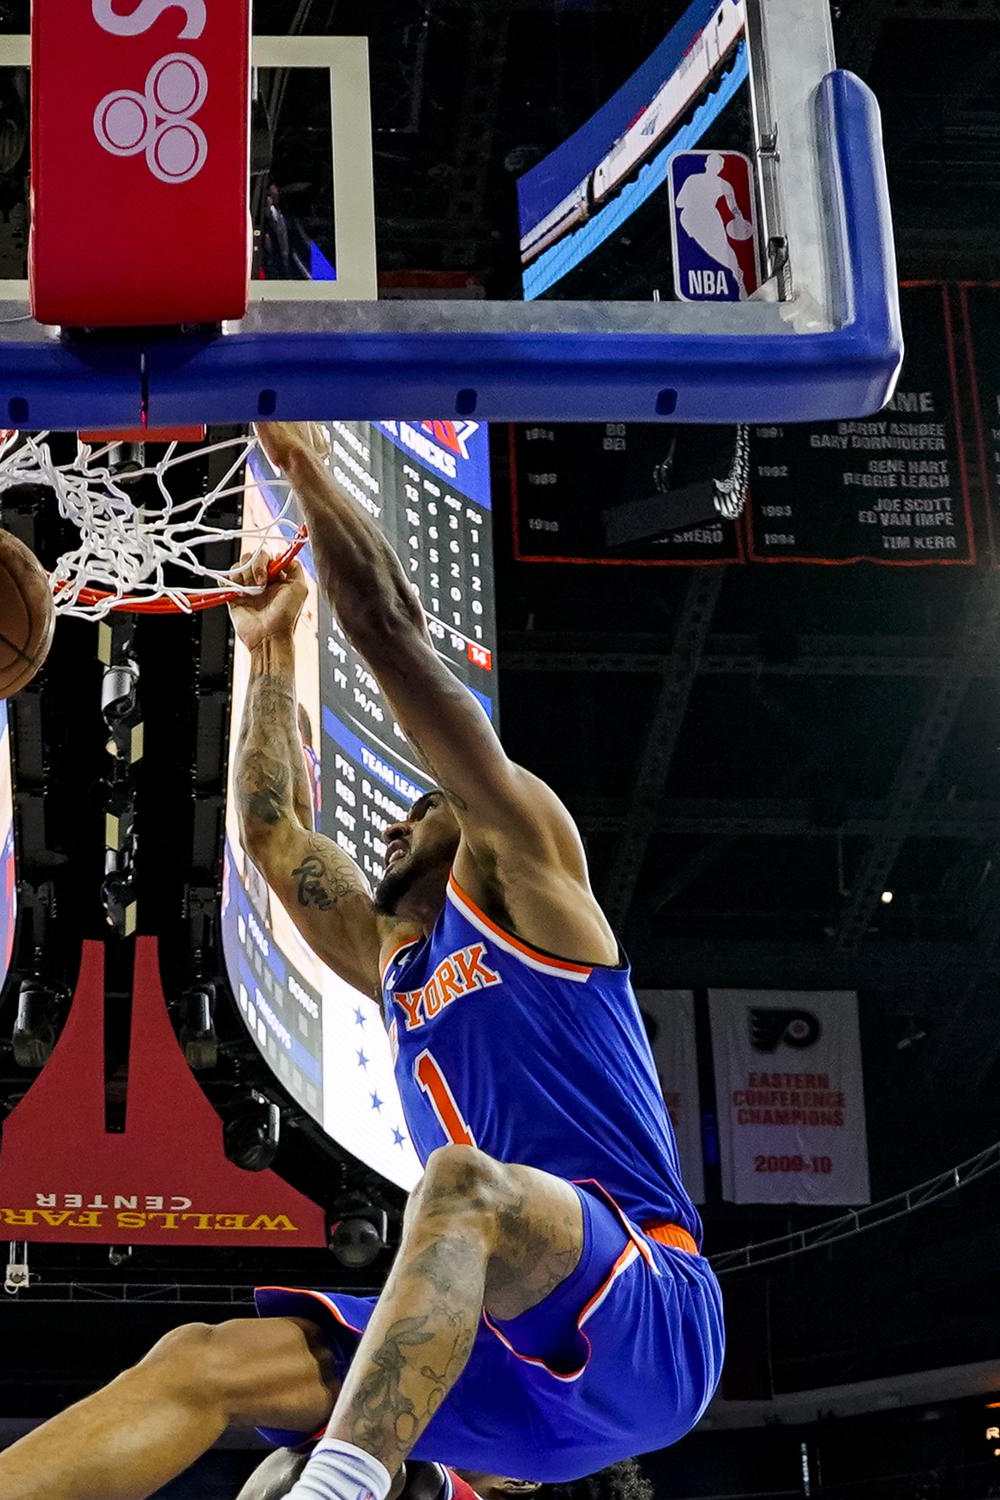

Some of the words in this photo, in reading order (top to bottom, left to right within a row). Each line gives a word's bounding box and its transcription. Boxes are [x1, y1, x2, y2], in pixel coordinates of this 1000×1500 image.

[689, 270, 729, 295] NBA
[838, 422, 888, 435] BARRY
[868, 459, 905, 473] GENE
[908, 460, 948, 473] HART
[843, 473, 898, 487] REGGIE
[901, 474, 950, 487] LEACH
[874, 498, 902, 511] JOE
[904, 497, 952, 511] SCOTT
[879, 513, 912, 526] VAN
[915, 513, 954, 526] IMPE
[882, 536, 911, 549] TIM
[914, 536, 957, 549] KERR
[335, 753, 356, 782] PTS
[361, 747, 394, 786] TEAM
[393, 942, 503, 1032] YORK
[748, 1071, 830, 1089] EASTERN
[412, 1048, 478, 1149] 1
[732, 1090, 846, 1108] CONFERENCE
[737, 1109, 845, 1126] CHAMPIONS
[35, 1193, 193, 1210] CENTER
[118, 1211, 298, 1231] WELLS
